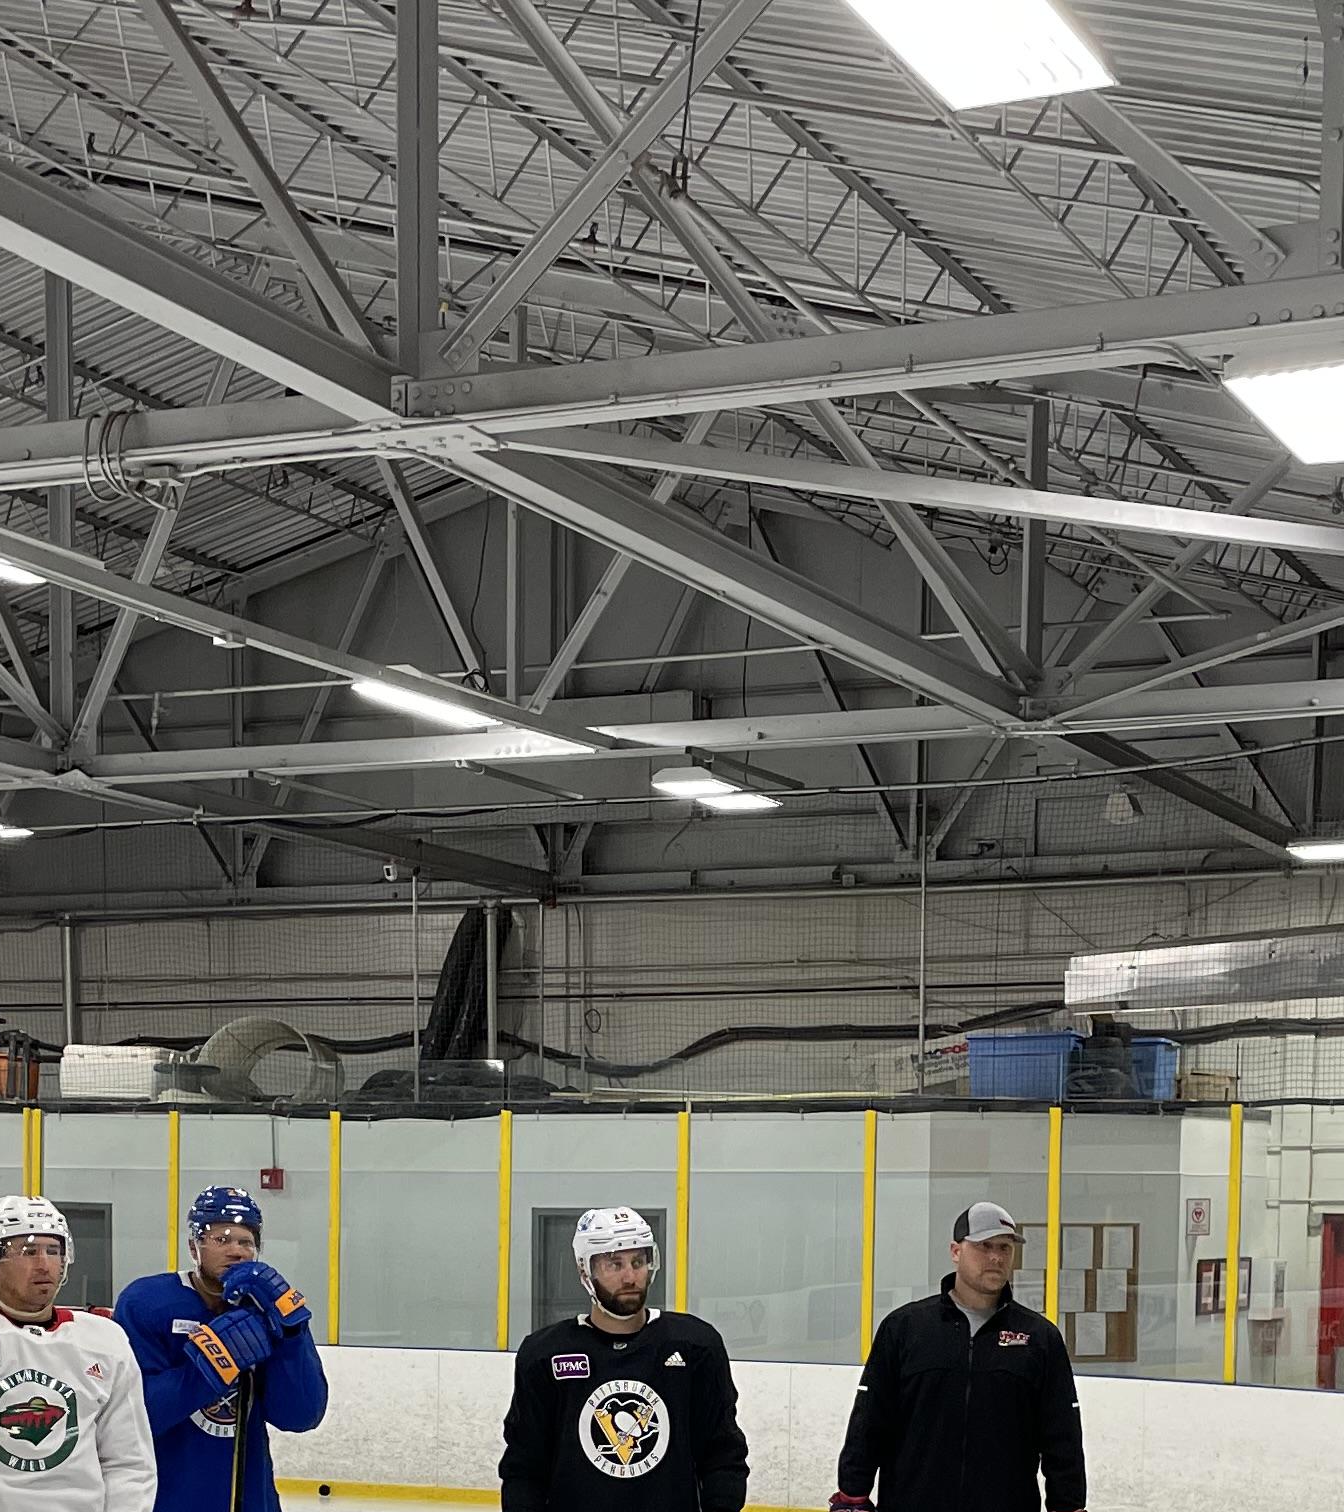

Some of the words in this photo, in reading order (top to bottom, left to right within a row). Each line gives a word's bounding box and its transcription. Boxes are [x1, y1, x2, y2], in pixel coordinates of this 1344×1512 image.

[554, 1360, 588, 1373] UPMC
[587, 1381, 658, 1406] PITTSBURGH
[9, 1456, 46, 1470] WILD
[594, 1452, 659, 1477] PENGUINS
